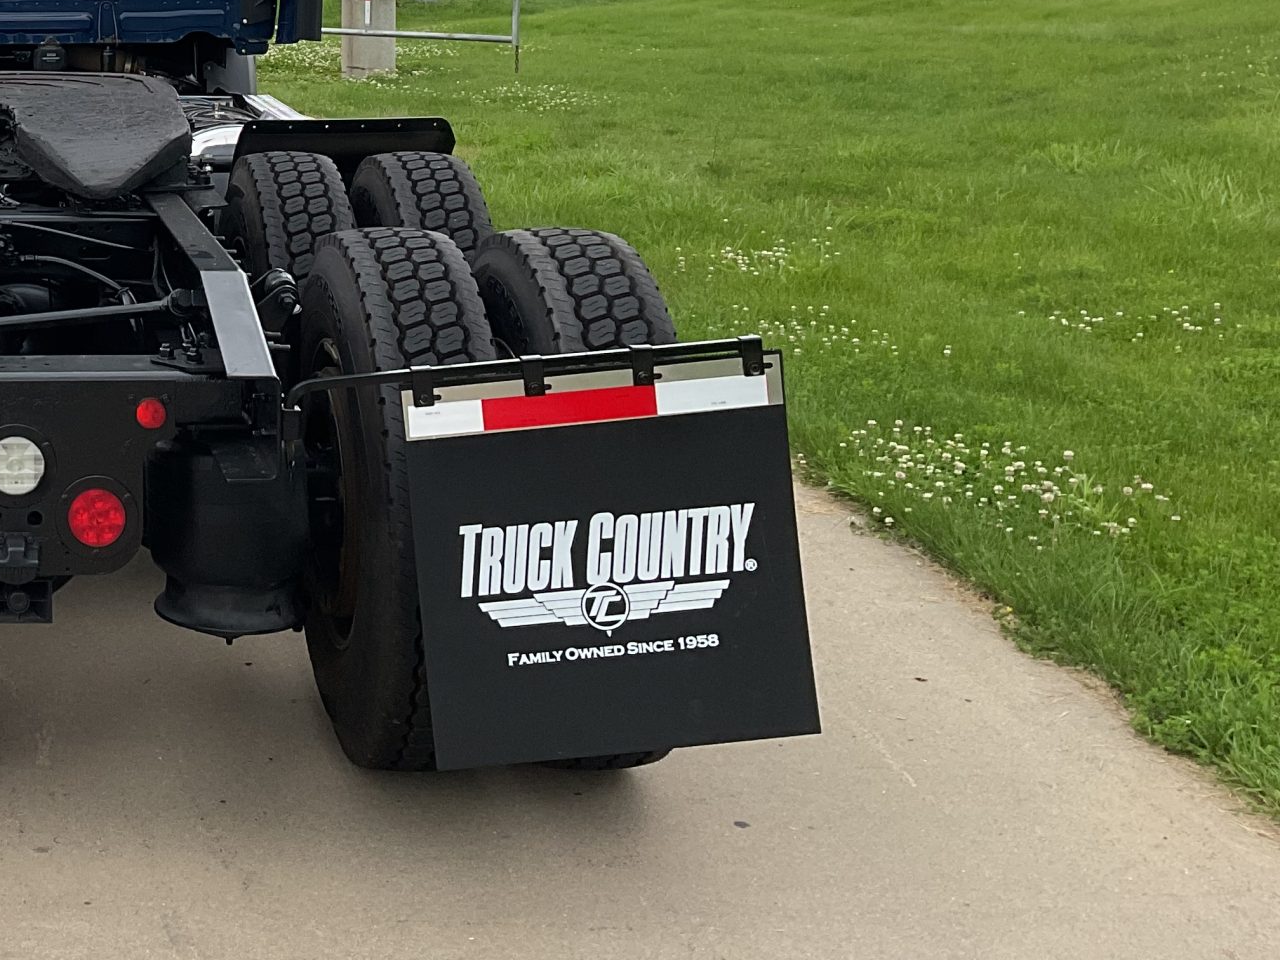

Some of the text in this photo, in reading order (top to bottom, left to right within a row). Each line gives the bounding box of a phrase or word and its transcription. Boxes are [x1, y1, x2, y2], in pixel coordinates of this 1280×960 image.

[458, 520, 579, 598] TRUCK
[507, 633, 720, 667] FAMILY OWNED SINCE 1958
